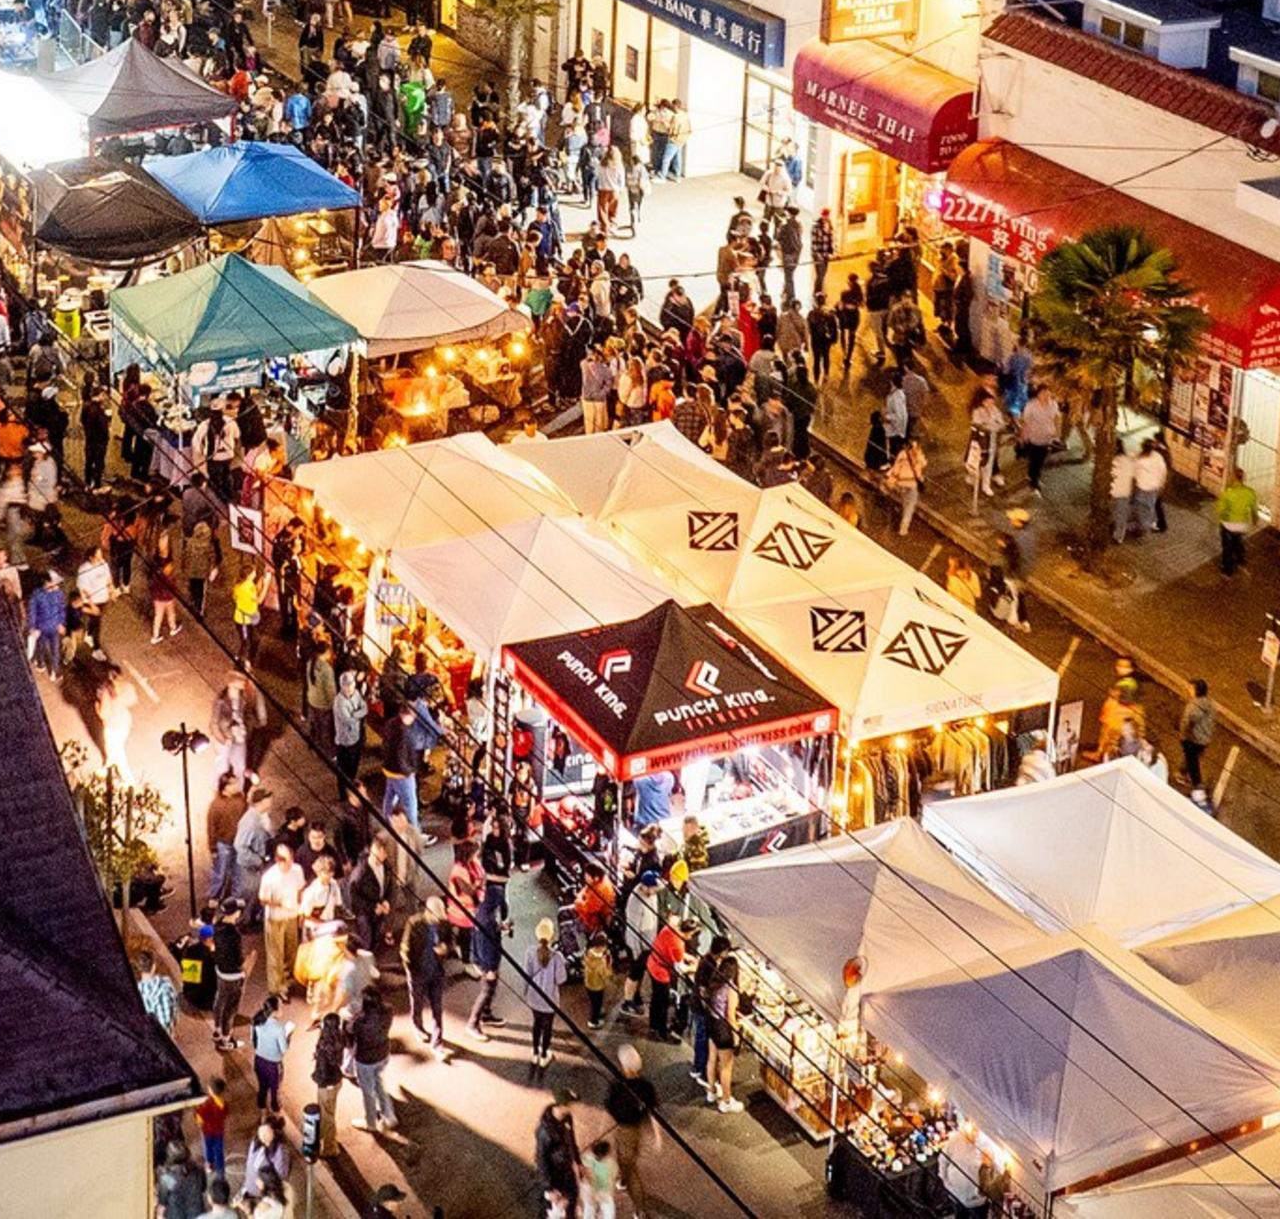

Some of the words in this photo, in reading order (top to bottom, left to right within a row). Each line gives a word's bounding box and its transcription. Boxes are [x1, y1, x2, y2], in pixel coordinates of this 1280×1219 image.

[853, 5, 895, 24] THAI
[805, 80, 869, 121] MARNEE
[877, 112, 915, 143] THAI
[943, 197, 991, 222] 2227
[992, 209, 1050, 251] Irving
